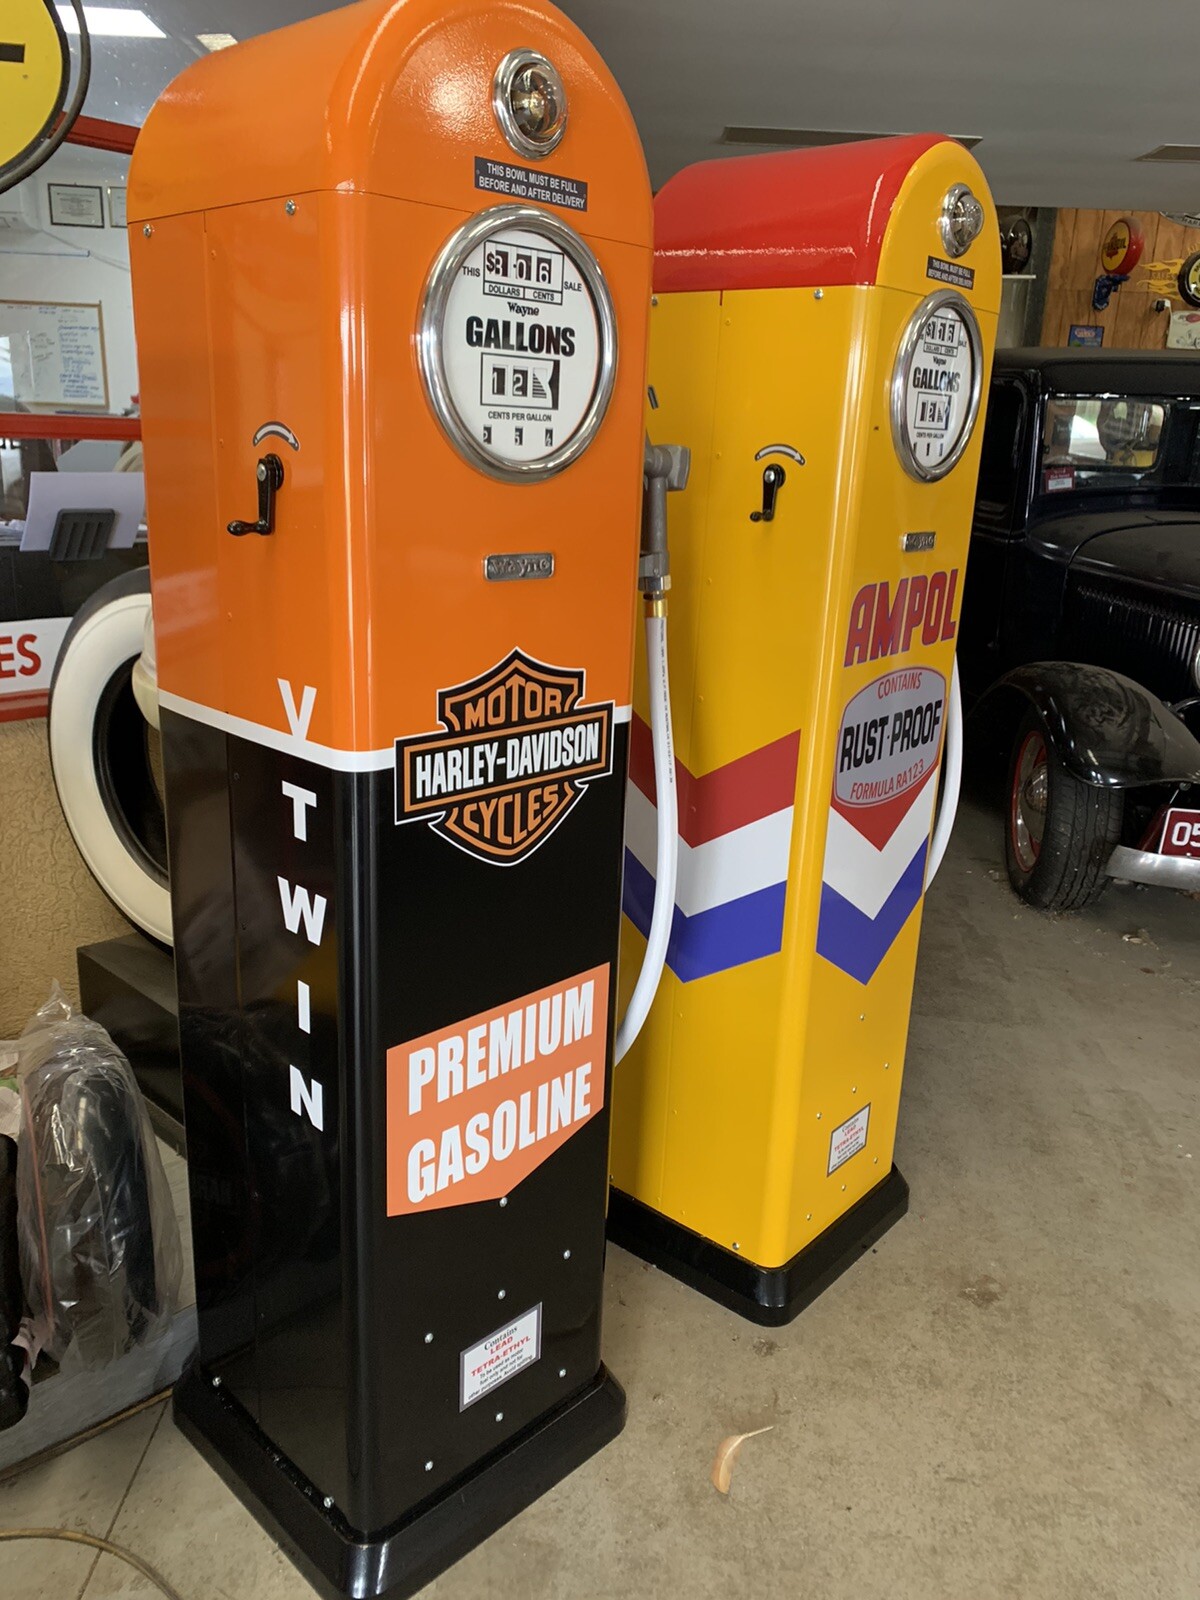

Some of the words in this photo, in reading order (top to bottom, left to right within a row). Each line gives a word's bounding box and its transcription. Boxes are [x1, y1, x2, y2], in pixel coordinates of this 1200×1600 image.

[479, 176, 510, 193] BEFORE
[511, 184, 527, 196] AND
[527, 187, 551, 202] AFTER
[551, 192, 585, 209] DELIVERY
[487, 162, 505, 177] THIS
[506, 167, 528, 182] BOWL
[529, 172, 549, 187] MUST
[549, 177, 560, 190] BE
[561, 180, 578, 194] FULL
[462, 265, 481, 278] THIS
[563, 280, 582, 292] SALE
[488, 284, 521, 297] DOLLARS
[532, 290, 555, 302] CENTS
[507, 301, 540, 317] Wayne
[465, 315, 576, 357] GALLONS
[912, 366, 961, 393] GALLONS
[487, 410, 511, 420] CENTS
[511, 412, 526, 421] PER
[526, 413, 552, 422] GALLON
[844, 568, 959, 668] AMPOL
[464, 673, 562, 730] MOTOR
[877, 671, 922, 700] CONTAINS
[415, 721, 600, 799] HARLEY-DAVIDSON
[850, 777, 895, 801] FORMULA
[896, 758, 925, 791] RA123
[462, 784, 560, 846] CYCLES
[408, 979, 595, 1116] PREMIUM
[407, 1061, 593, 1204] GASOLINE
[484, 1326, 518, 1350] Contains
[490, 1336, 513, 1355] LEAD
